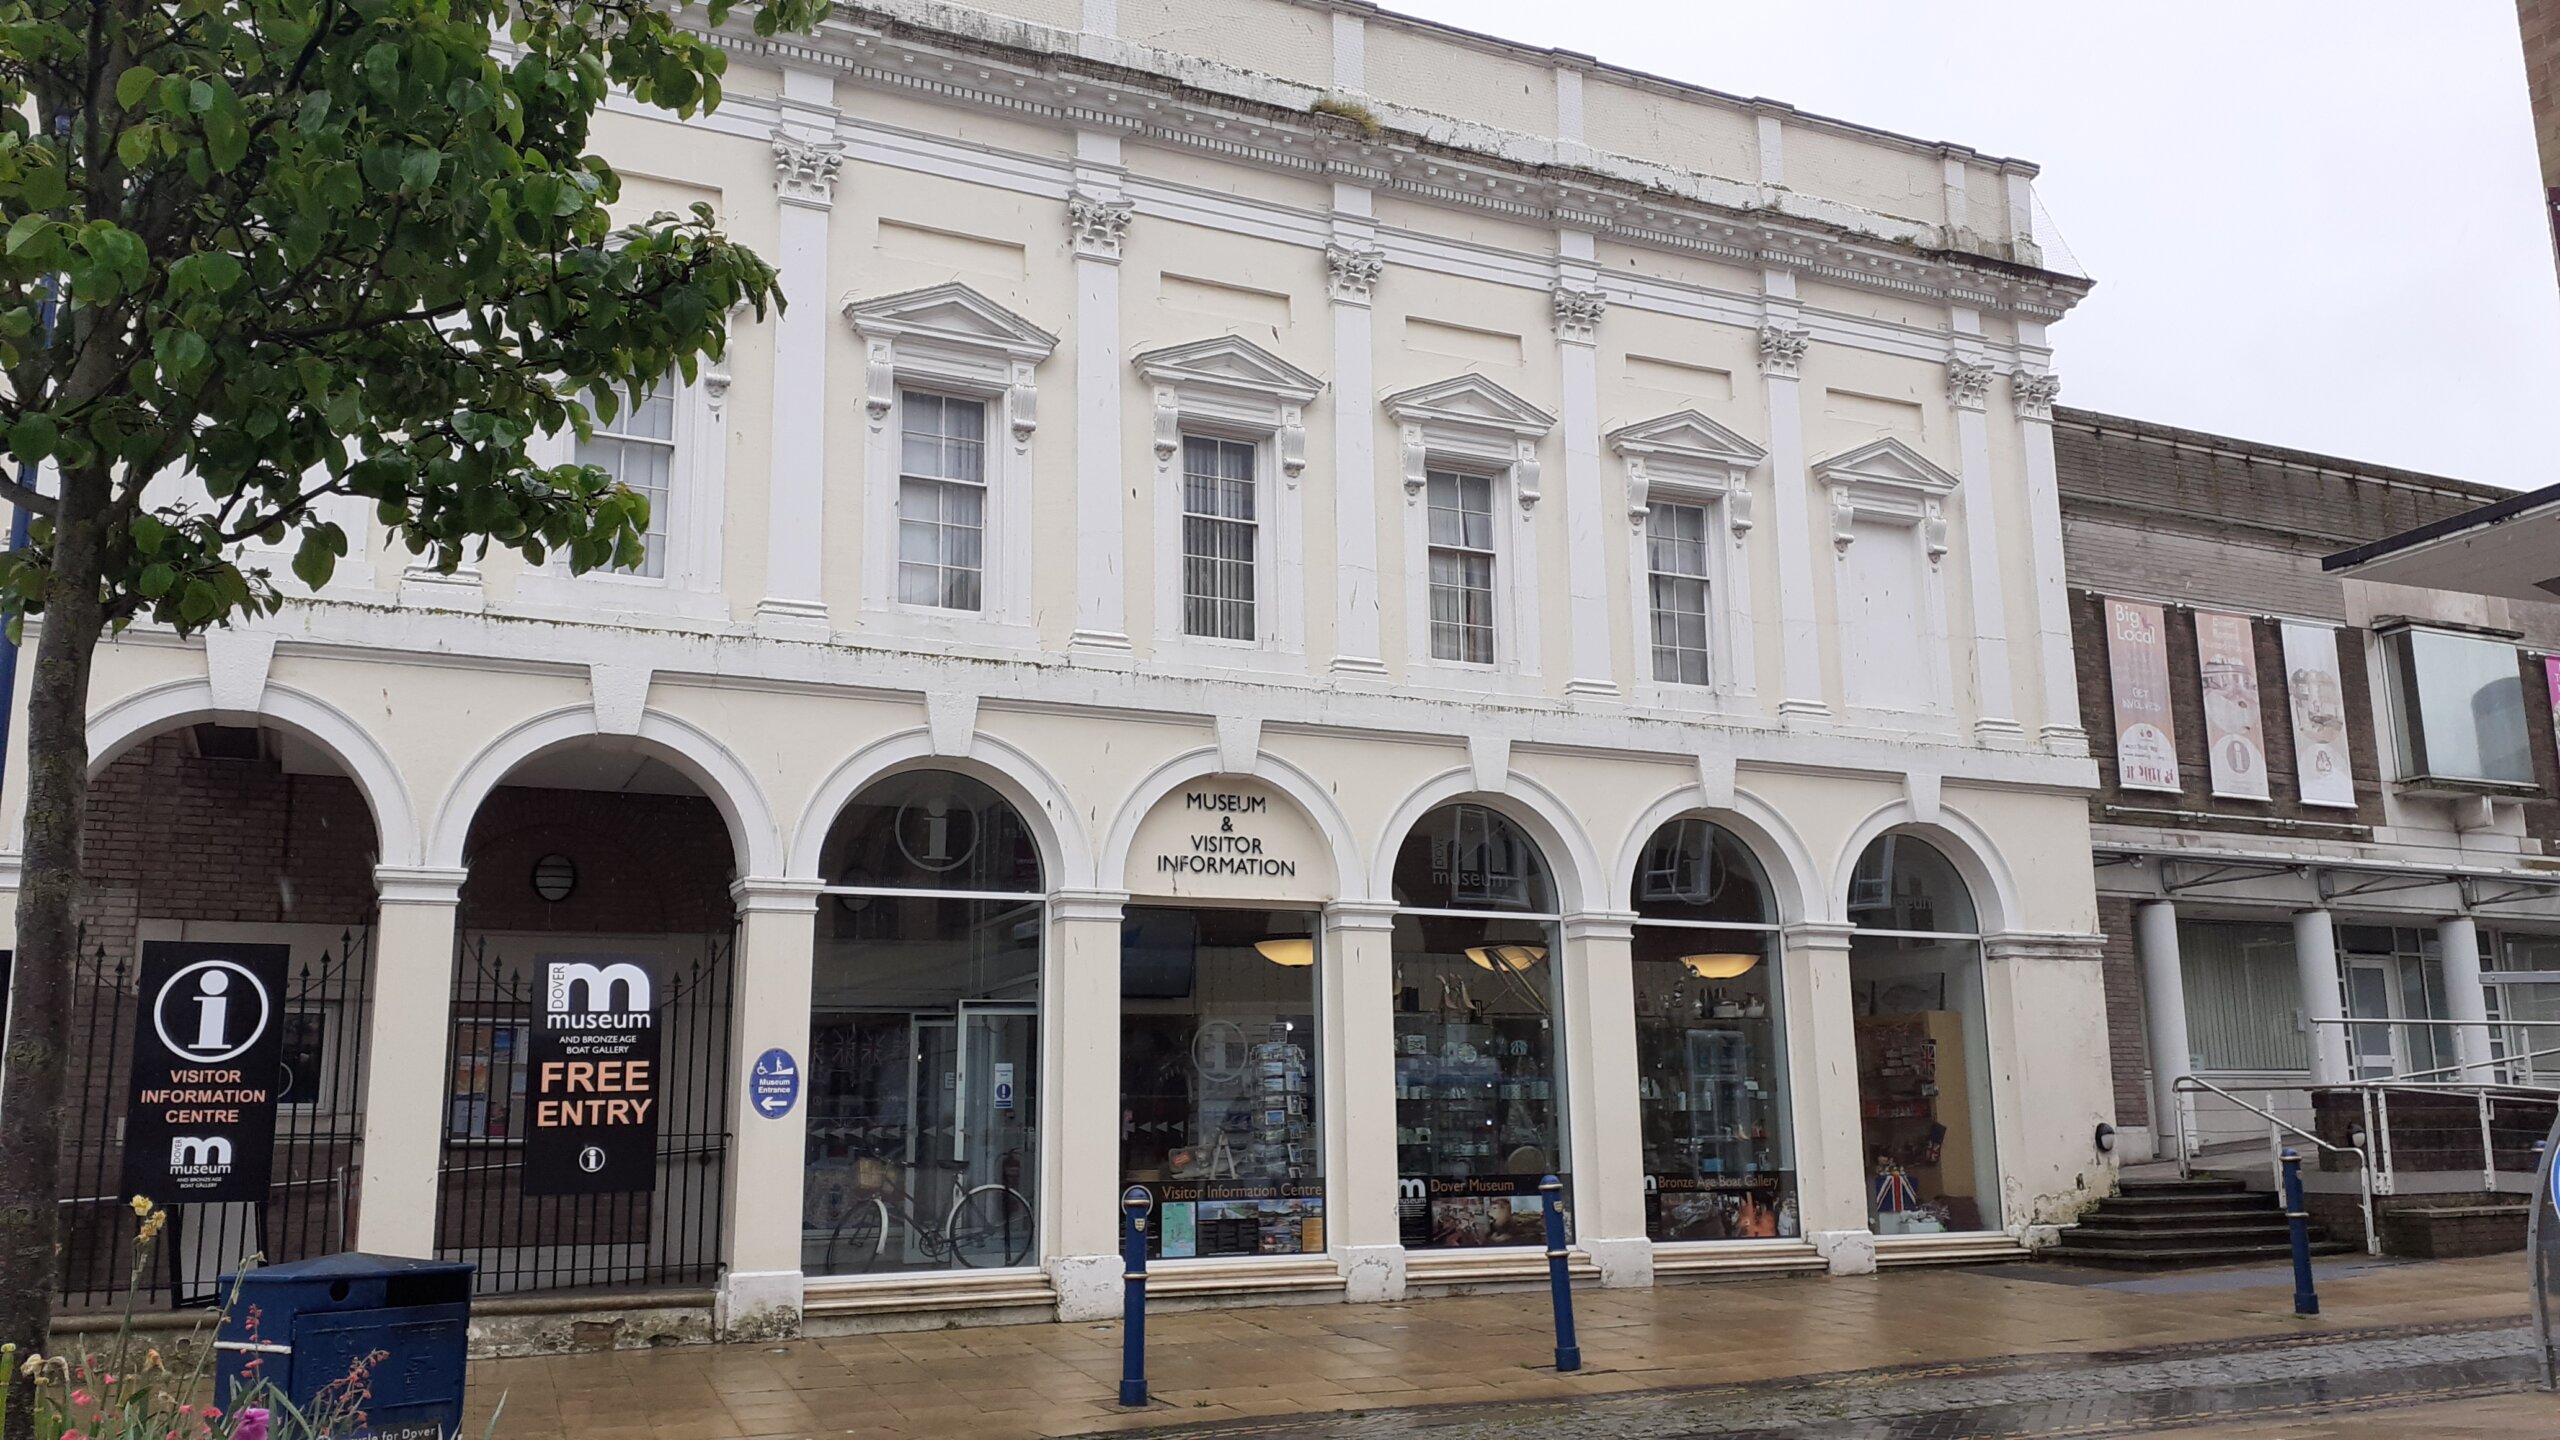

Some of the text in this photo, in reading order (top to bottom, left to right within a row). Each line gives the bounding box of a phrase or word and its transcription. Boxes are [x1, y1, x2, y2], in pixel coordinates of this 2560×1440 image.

[2115, 604, 2139, 628] Big
[2117, 622, 2156, 644] Local
[1187, 792, 1266, 813] MUSEUM
[1221, 816, 1233, 832] &
[1191, 834, 1263, 854] VISITOR
[1157, 855, 1295, 877] INFORMATION
[552, 965, 565, 1009] DOVER
[547, 1013, 651, 1029] museum
[559, 1035, 637, 1044] AND BRONZE AGE
[566, 1045, 629, 1054] BOAT GALLERY
[170, 1069, 242, 1083] VISITOR
[540, 1061, 650, 1093] FREE
[759, 1078, 791, 1086] Museum
[140, 1089, 266, 1103] INFORMATION
[757, 1086, 791, 1094] Entrance
[165, 1109, 240, 1123] CENTRE
[537, 1098, 652, 1127] ENTRY
[173, 1139, 182, 1164] DOVER
[169, 1165, 232, 1175] museum
[1430, 1179, 1515, 1193] Dover Museum
[1658, 1173, 1779, 1191] Bronze Age Boat Gallery
[1162, 1182, 1322, 1199] Visitor Information Centre
[382, 1431, 399, 1440] for
[402, 1427, 436, 1440] Dover
